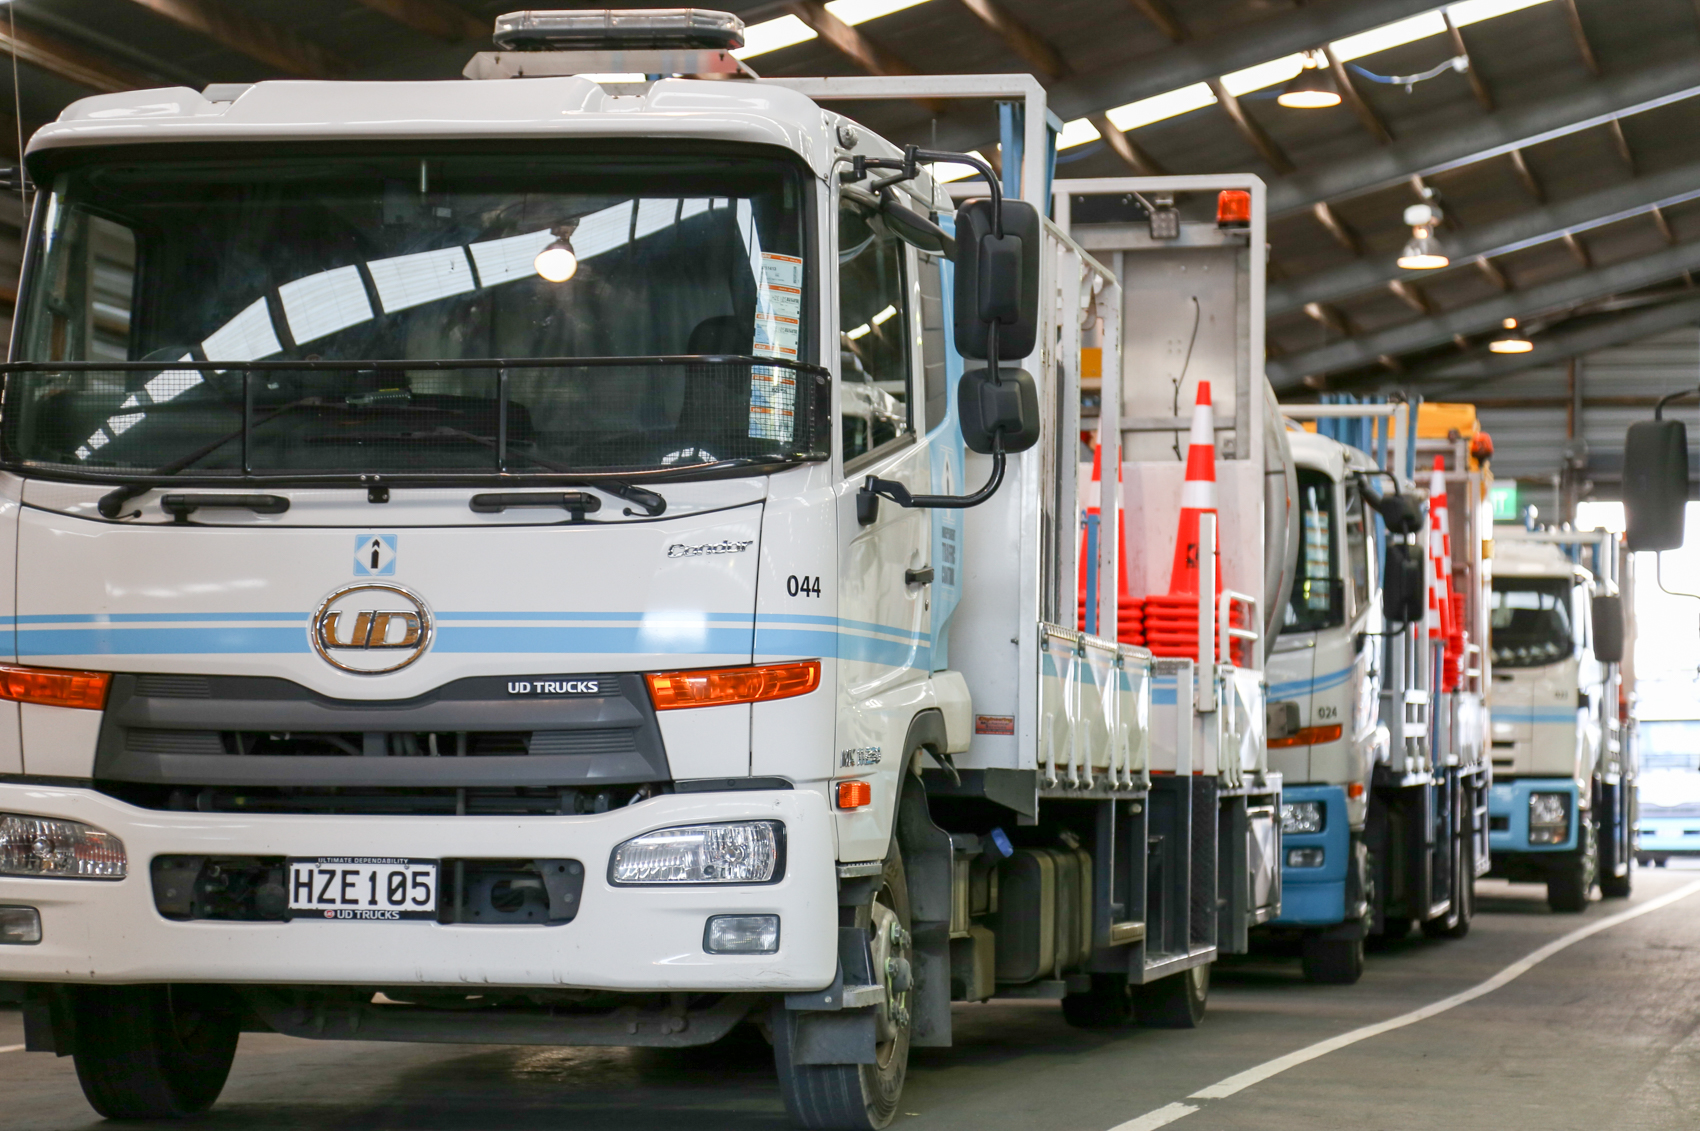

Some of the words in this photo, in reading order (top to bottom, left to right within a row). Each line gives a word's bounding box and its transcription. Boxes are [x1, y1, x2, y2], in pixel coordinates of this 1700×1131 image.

[668, 540, 753, 558] Condor
[786, 574, 821, 598] 044
[321, 610, 422, 651] UD
[507, 682, 531, 694] UD
[533, 681, 599, 693] TRUCKS
[1318, 706, 1338, 719] 024
[293, 869, 431, 906] HZE105
[337, 910, 353, 919] UD
[355, 910, 400, 920] TRUCKS
